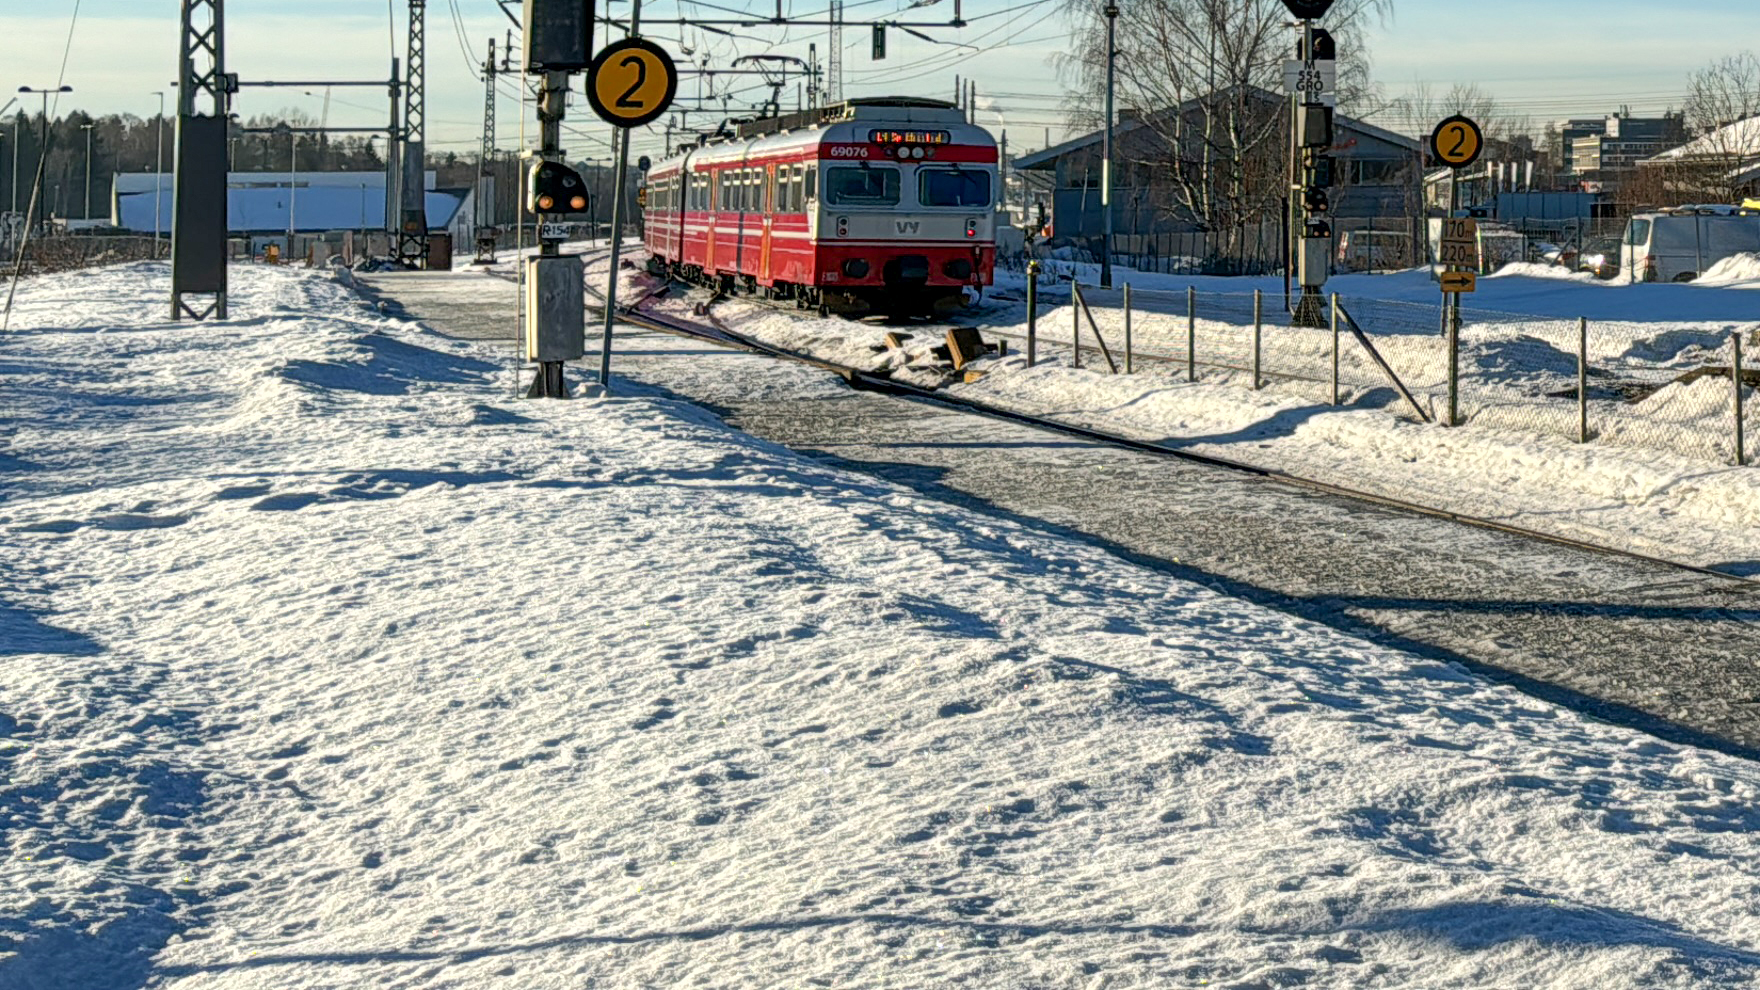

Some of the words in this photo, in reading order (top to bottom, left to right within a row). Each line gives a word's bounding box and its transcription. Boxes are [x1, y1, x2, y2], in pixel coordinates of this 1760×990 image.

[1304, 60, 1316, 71] M
[1298, 70, 1321, 81] 554
[615, 56, 646, 108] 2
[1296, 80, 1324, 92] GRO
[1448, 126, 1465, 157] 2
[830, 146, 869, 158] 69076
